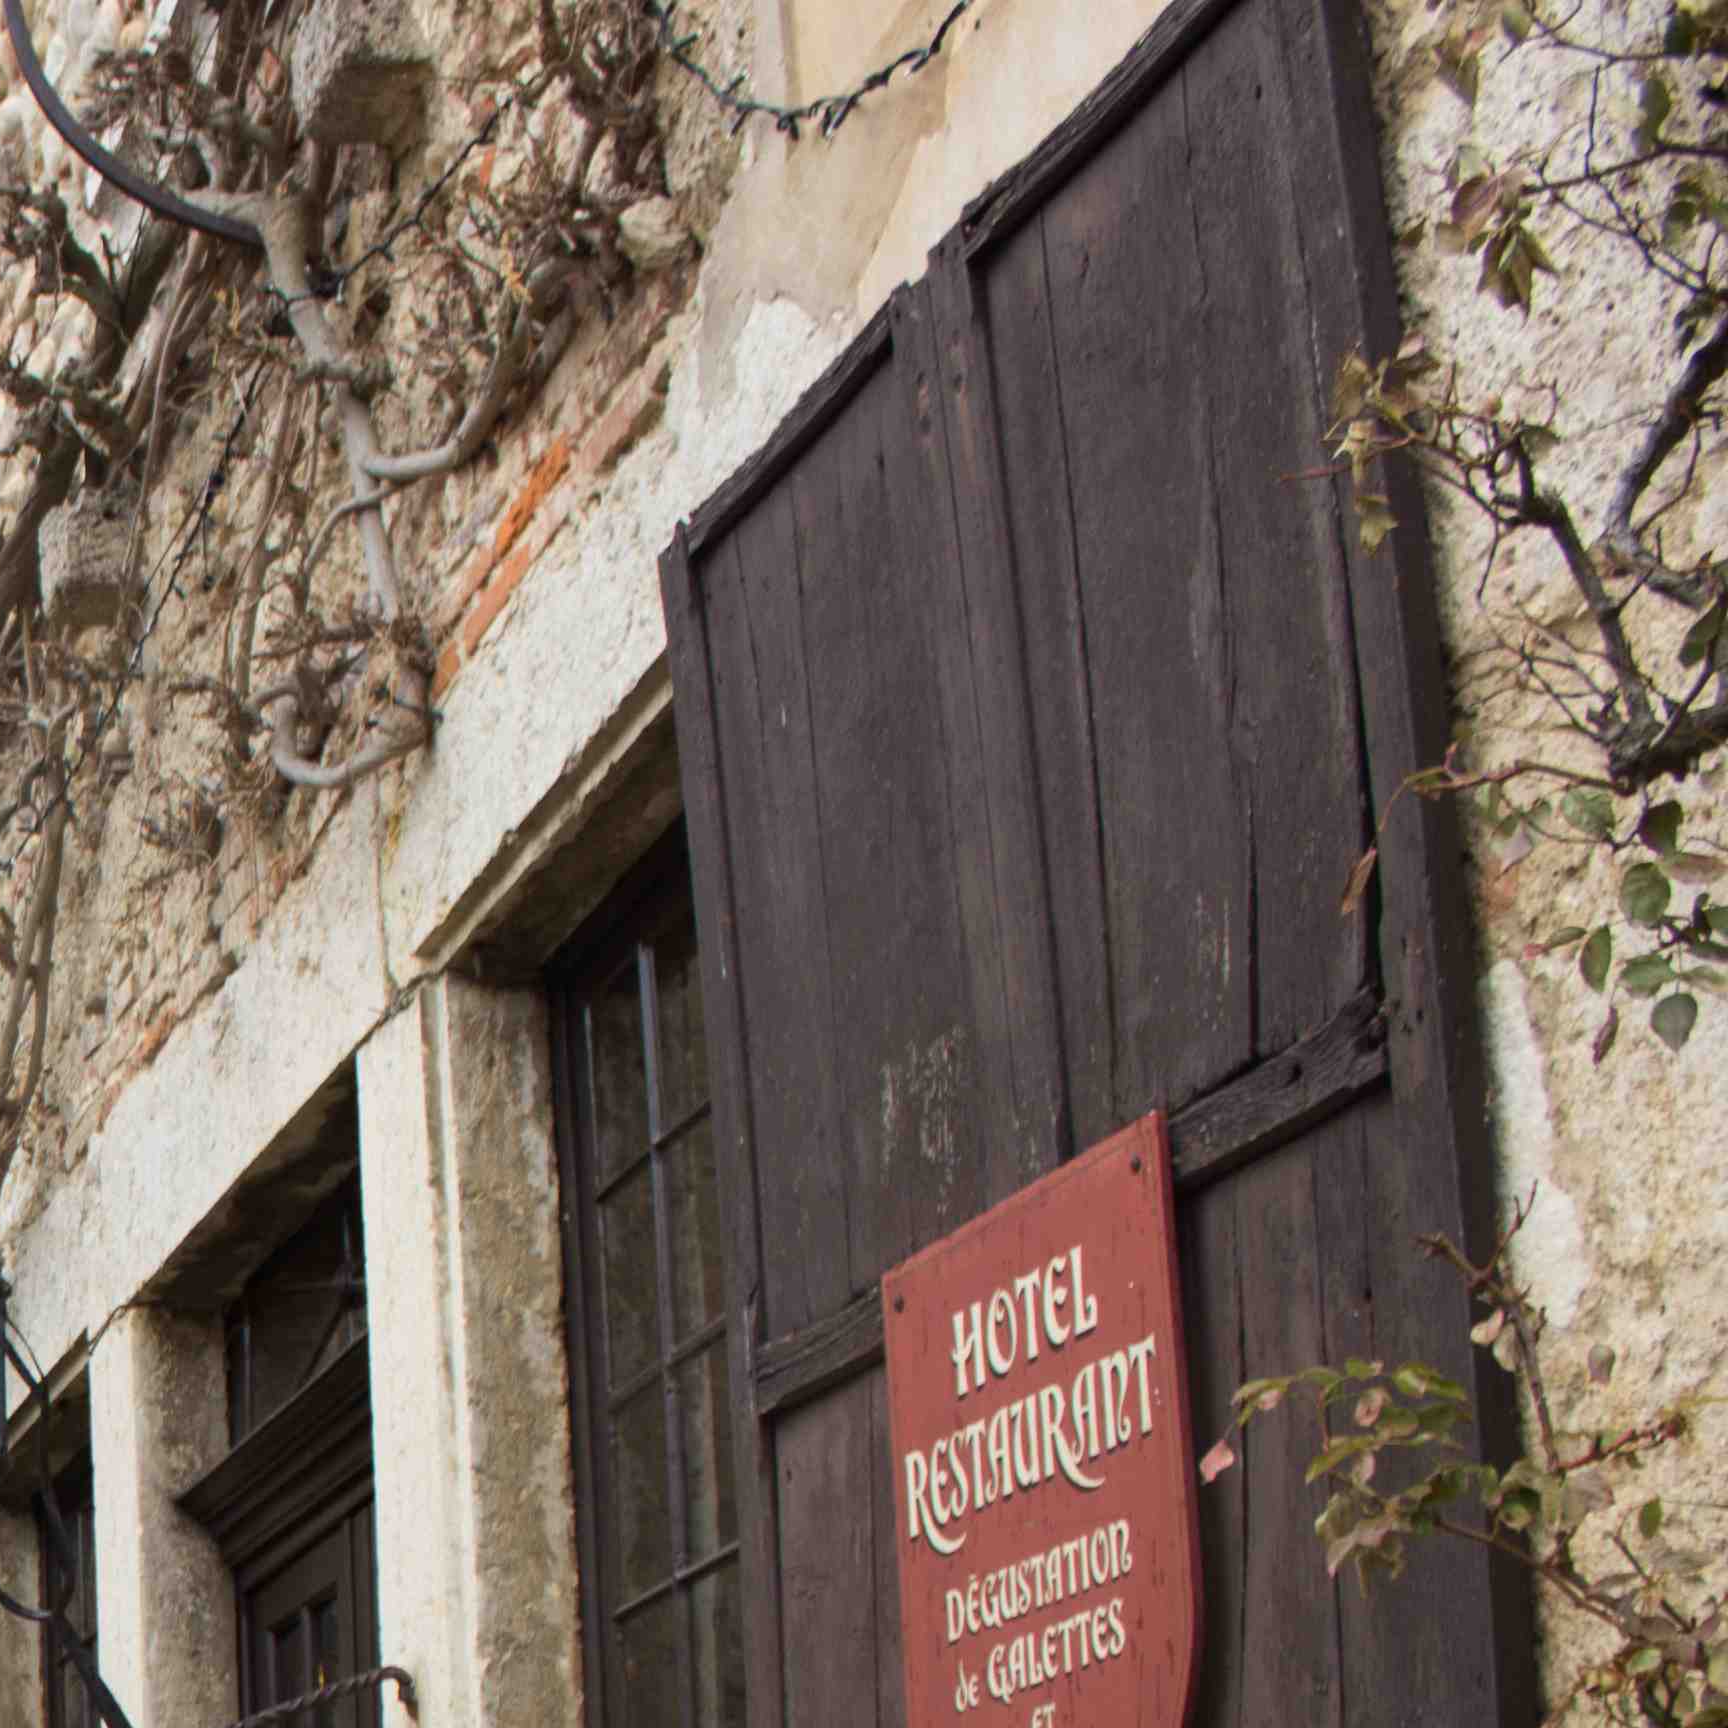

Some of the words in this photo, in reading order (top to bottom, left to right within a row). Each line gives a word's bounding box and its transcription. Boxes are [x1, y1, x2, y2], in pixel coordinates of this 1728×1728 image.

[950, 1244, 1098, 1398] HOTEL
[904, 1331, 1157, 1555] RESTAURANT
[987, 1597, 1126, 1704] GALETTES
